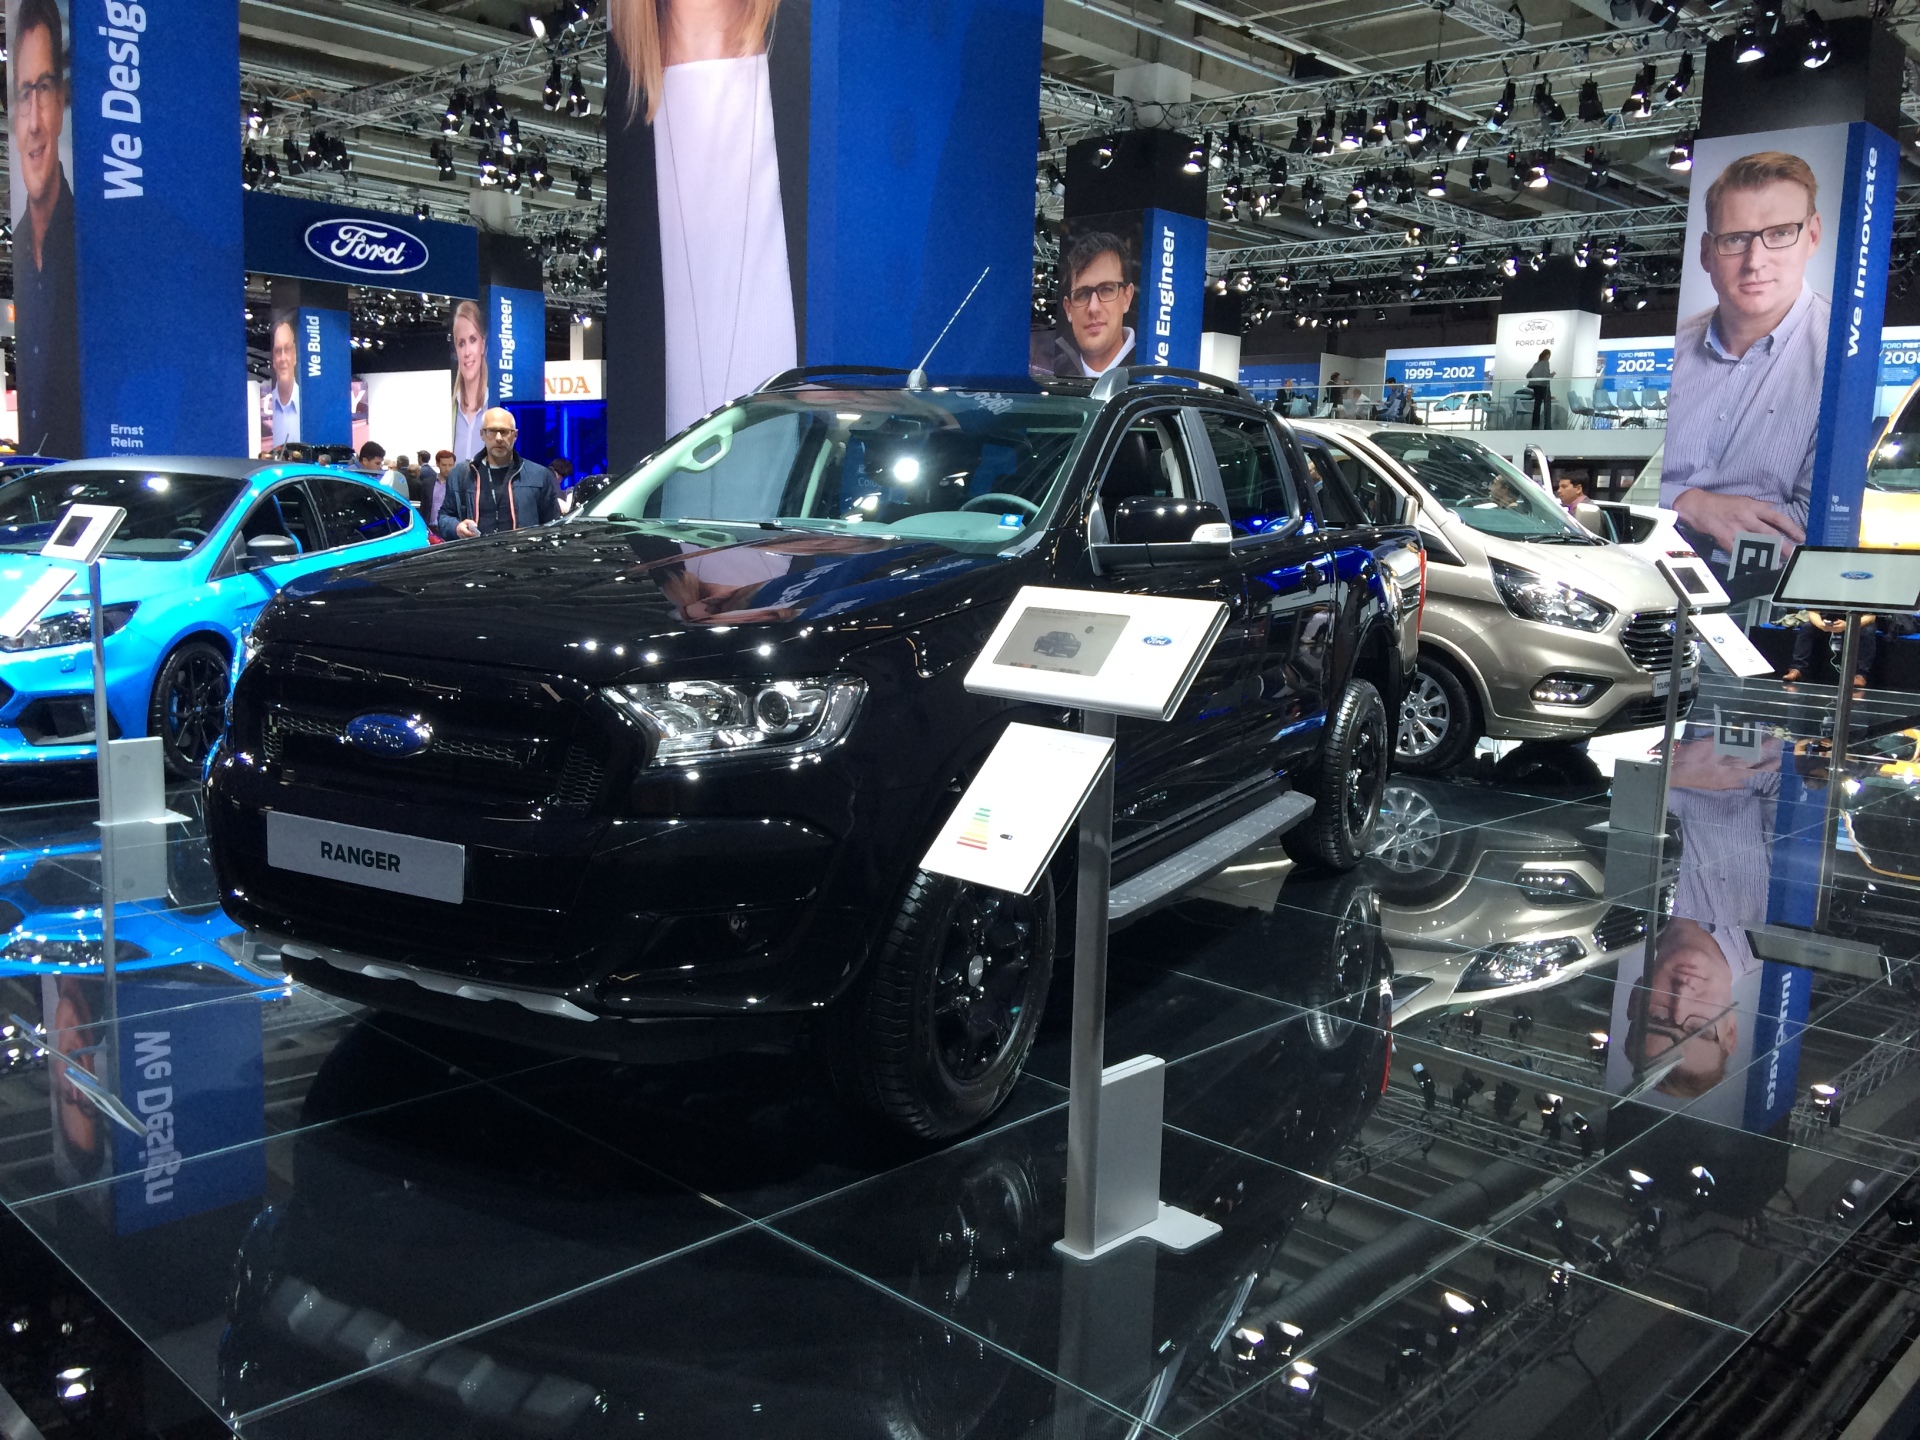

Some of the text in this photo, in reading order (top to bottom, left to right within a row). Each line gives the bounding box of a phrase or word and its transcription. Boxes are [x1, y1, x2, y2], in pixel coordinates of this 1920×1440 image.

[98, 0, 147, 199] We Desig
[331, 225, 406, 265] Ford
[1847, 147, 1878, 358] We Innovate
[1156, 226, 1175, 337] Engineer
[306, 315, 321, 377] We Build
[499, 296, 516, 399] We Engineer
[1884, 351, 1920, 365] 200
[110, 423, 144, 436] Ernst
[1146, 635, 1168, 646] Ford
[320, 840, 401, 873] RANGER
